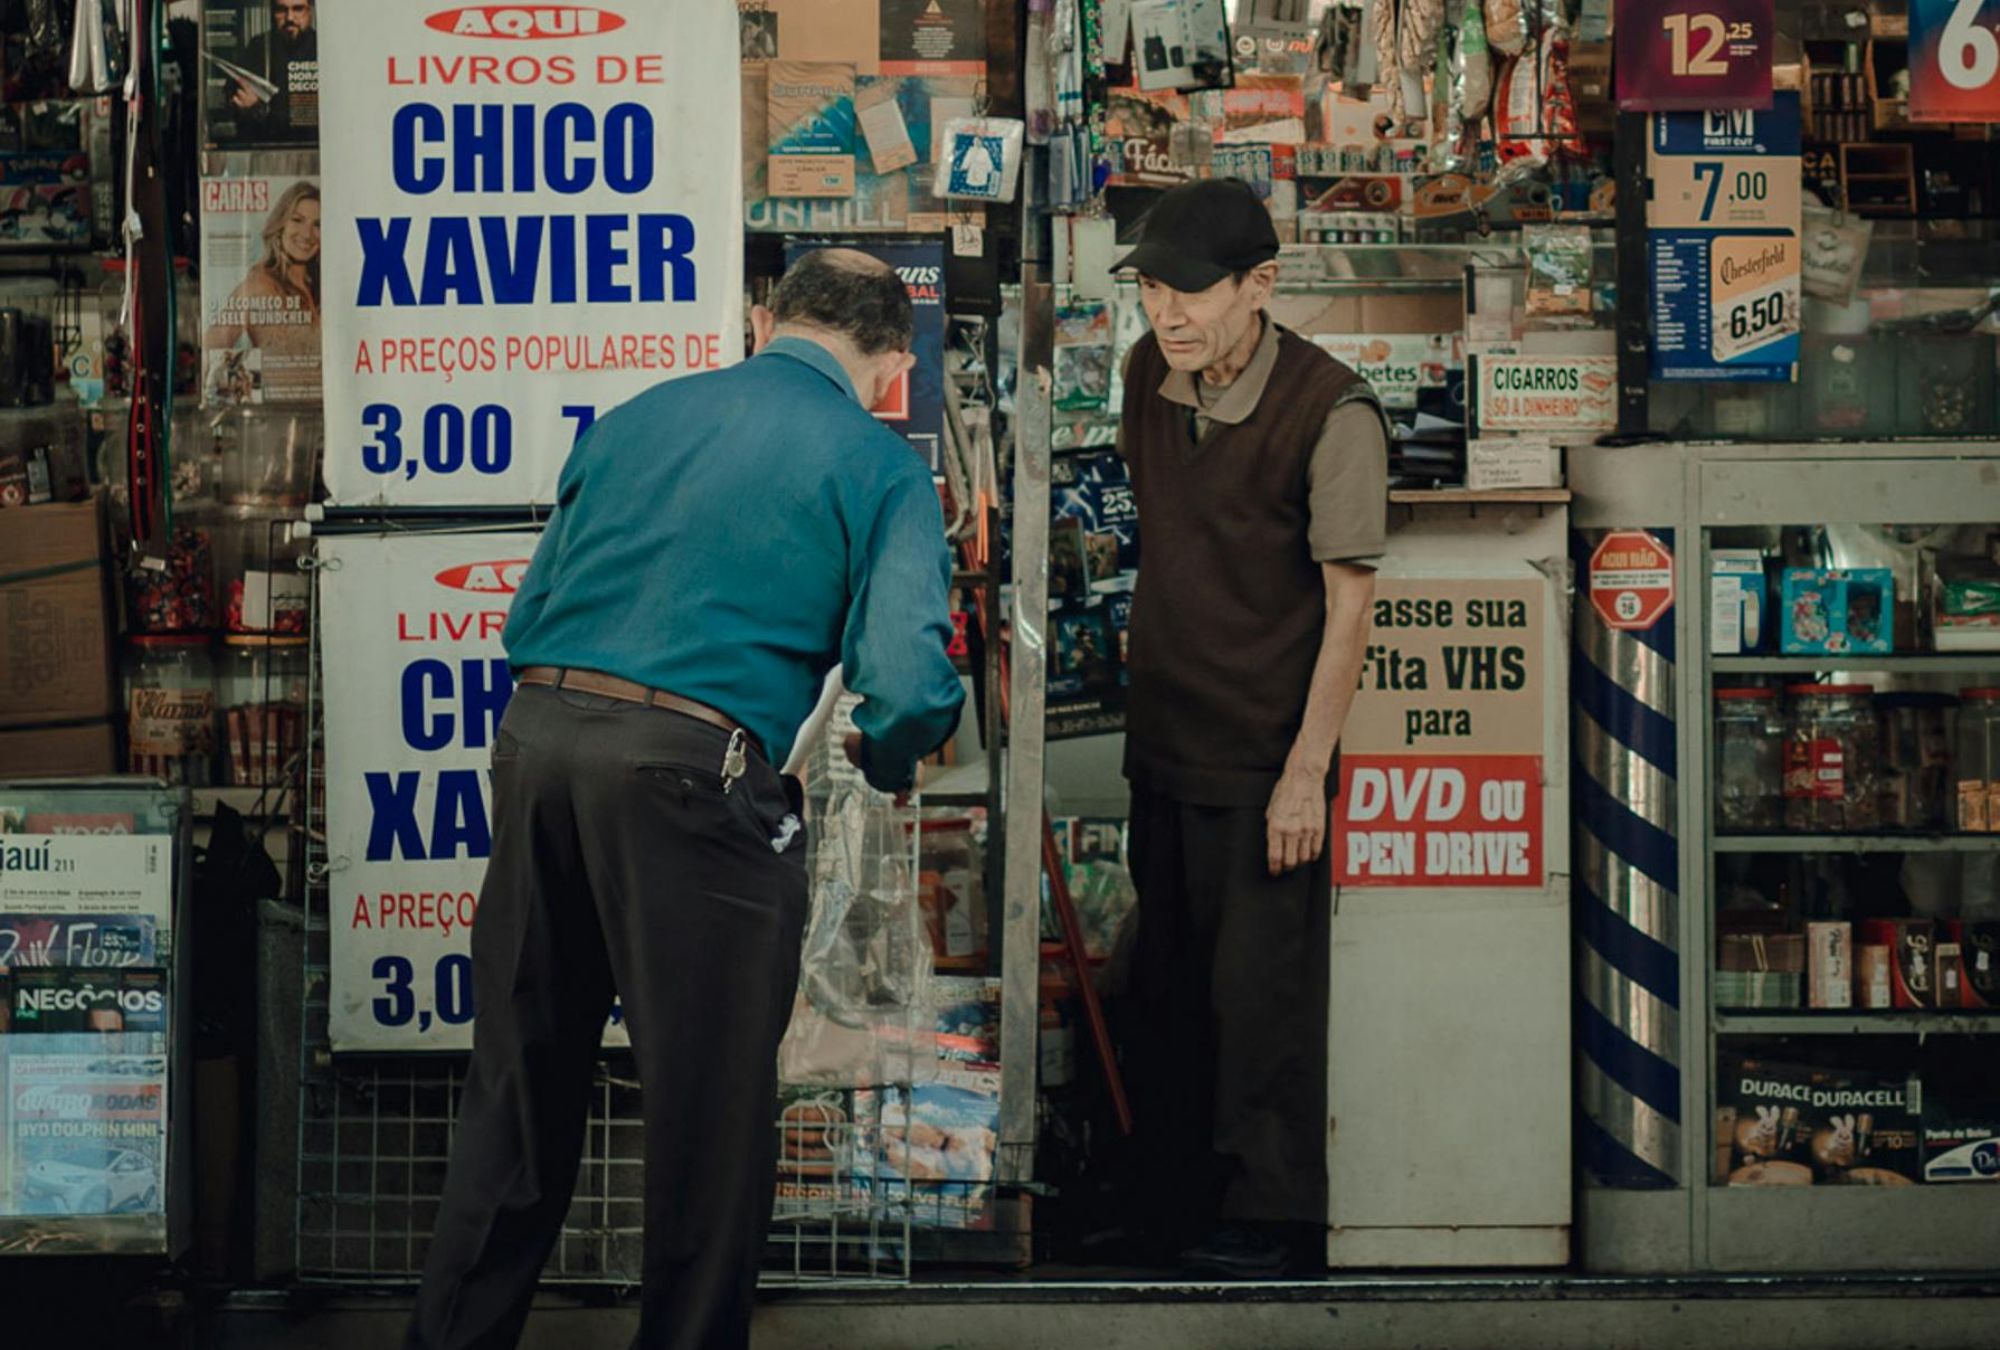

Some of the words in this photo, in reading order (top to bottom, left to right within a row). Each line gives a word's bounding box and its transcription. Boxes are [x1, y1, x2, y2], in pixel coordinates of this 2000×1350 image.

[454, 9, 600, 38] AQUI
[387, 56, 576, 85] LIVROS
[597, 55, 665, 84] DE
[392, 102, 654, 195] CHICO
[206, 181, 268, 212] CARAS
[1694, 162, 1767, 221] 7,00
[356, 214, 698, 306] XAVIER
[1720, 243, 1785, 285] Chesterfield
[1731, 291, 1783, 339] 6,50
[355, 340, 373, 374] A
[382, 337, 496, 383] PREÇOS
[506, 334, 675, 371] POPULARES
[686, 334, 721, 369] DE
[1494, 367, 1578, 390] CIGARROS
[362, 403, 512, 481] 3,00
[1602, 552, 1628, 568] AQUI
[1630, 547, 1657, 567] NÃO
[398, 611, 507, 641] LIVR
[1374, 600, 1453, 628] asse
[1466, 599, 1526, 628] sua
[1442, 646, 1526, 690] VHS
[401, 658, 514, 751] CH
[1406, 709, 1471, 745] para
[1347, 768, 1466, 821] DVD
[1480, 781, 1526, 821] OU
[54, 859, 75, 872] 211
[1346, 831, 1416, 876] PEN
[1426, 831, 1529, 876] DRIVE
[352, 894, 372, 929] A
[380, 892, 478, 938] PREÇO
[371, 954, 476, 1033] 3,0
[1813, 1090, 1905, 1107] DURACELL
[17, 1122, 49, 1137] BYD
[52, 1122, 120, 1137] DOLPHIN
[123, 1122, 157, 1137] MINI
